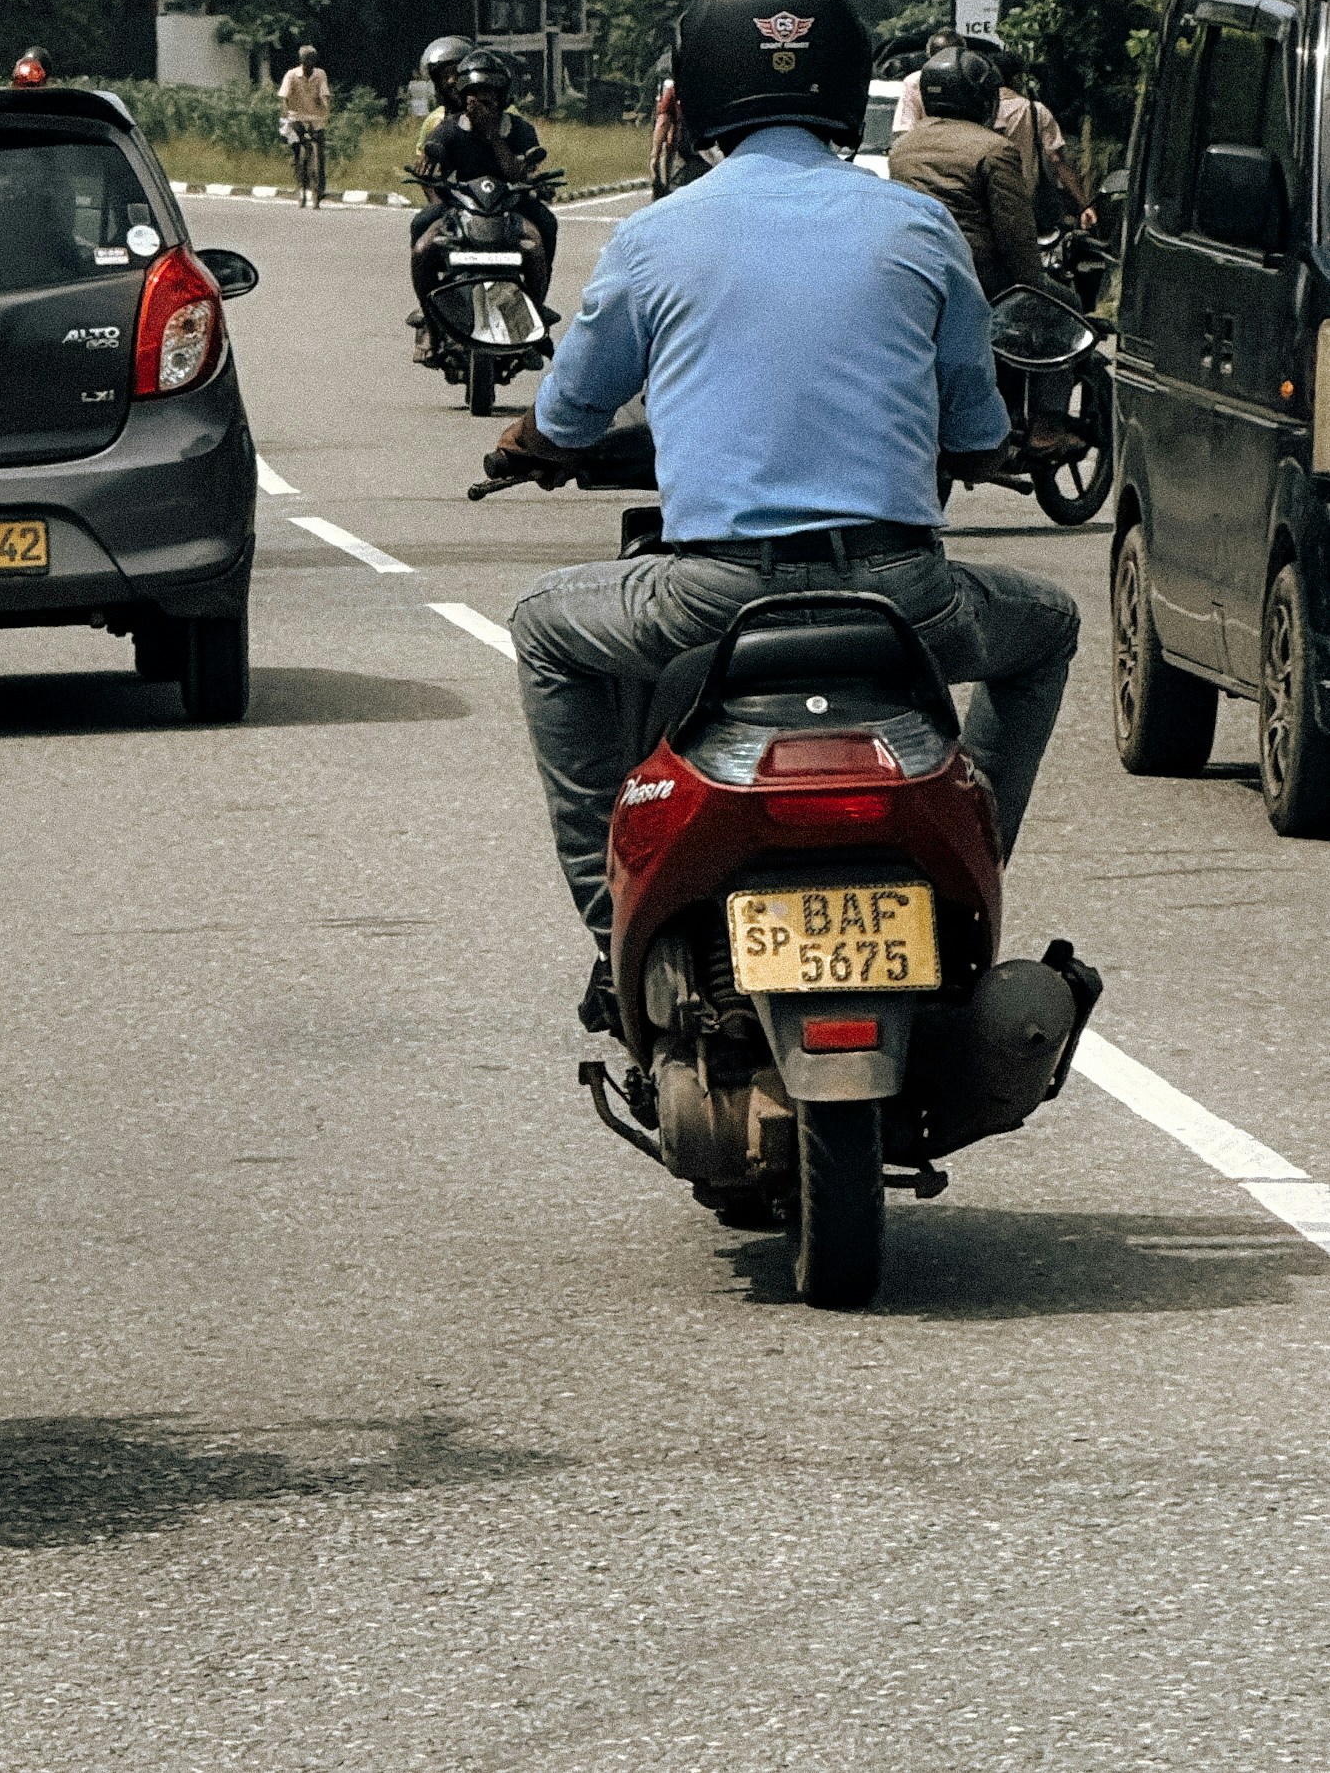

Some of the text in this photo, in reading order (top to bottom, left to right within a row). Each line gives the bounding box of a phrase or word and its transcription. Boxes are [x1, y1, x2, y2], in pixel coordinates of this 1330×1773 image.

[61, 326, 121, 344] ALTO
[802, 890, 910, 937] BAF
[746, 926, 791, 957] SP
[798, 939, 910, 983] 5675
